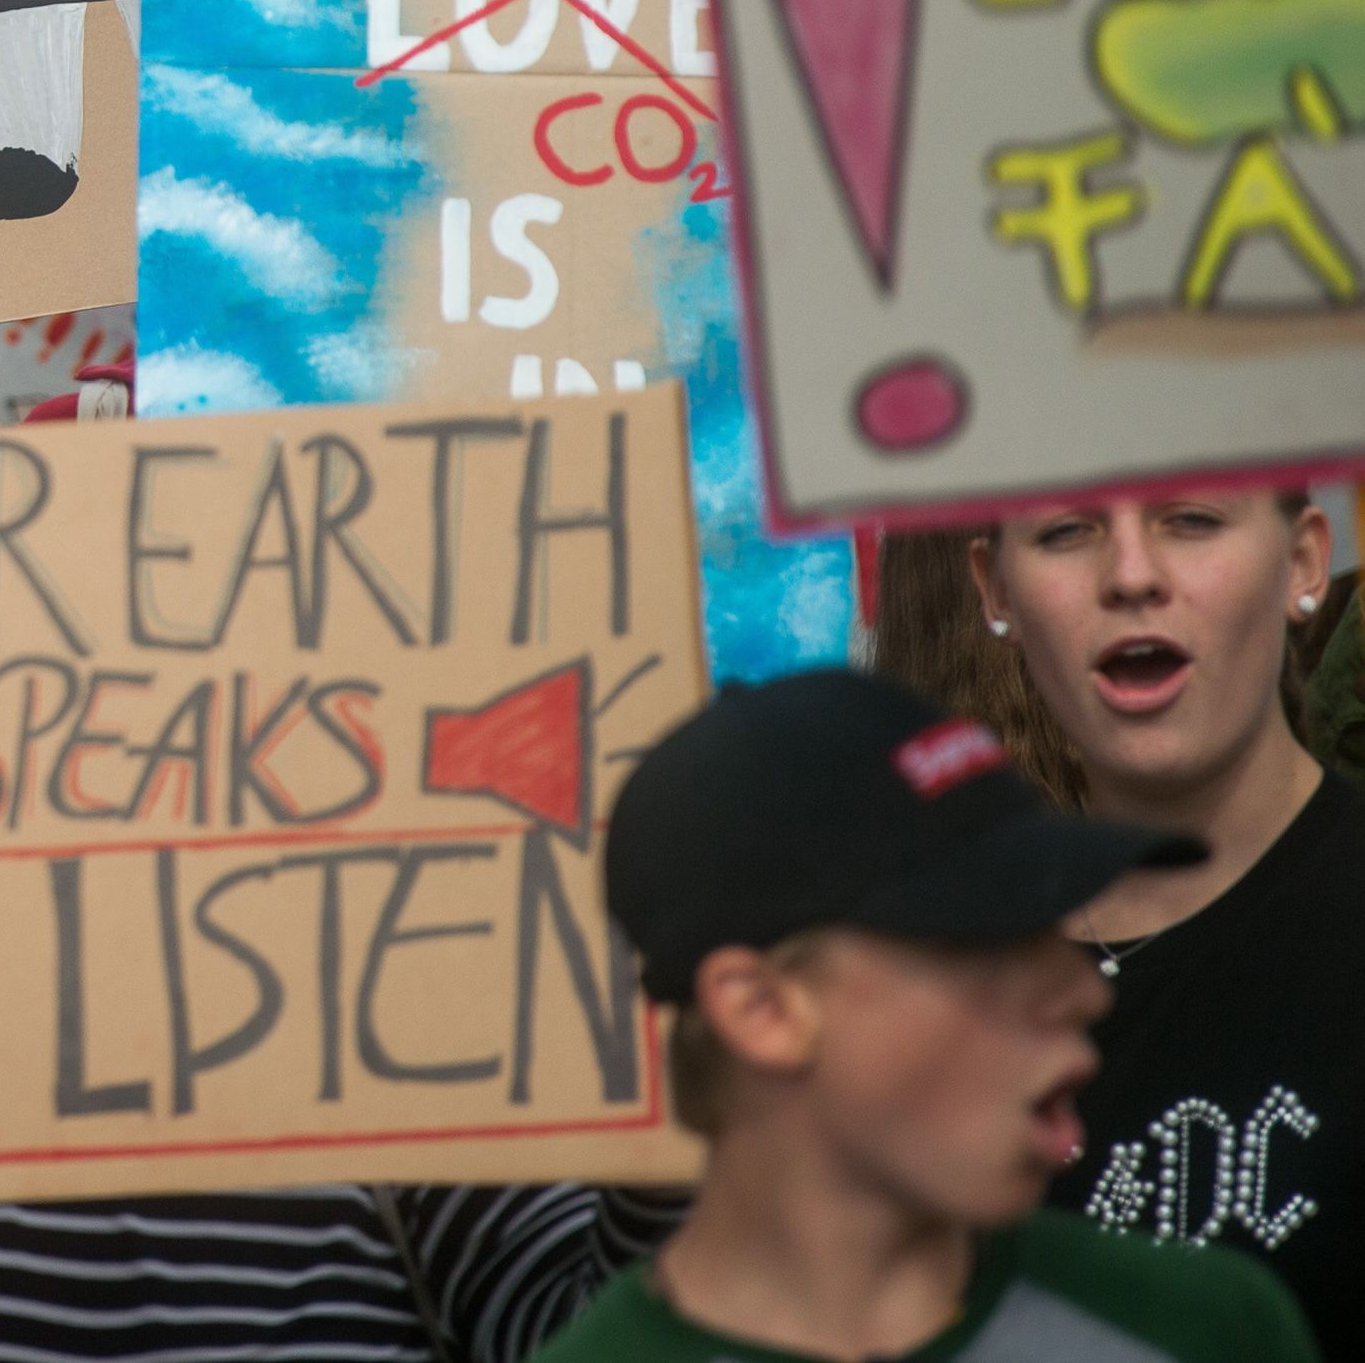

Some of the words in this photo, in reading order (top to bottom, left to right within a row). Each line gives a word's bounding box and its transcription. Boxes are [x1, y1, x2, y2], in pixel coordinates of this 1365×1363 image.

[440, 192, 564, 330] IS
[130, 412, 630, 652] EARTH
[49, 825, 641, 1119] LISTEN
